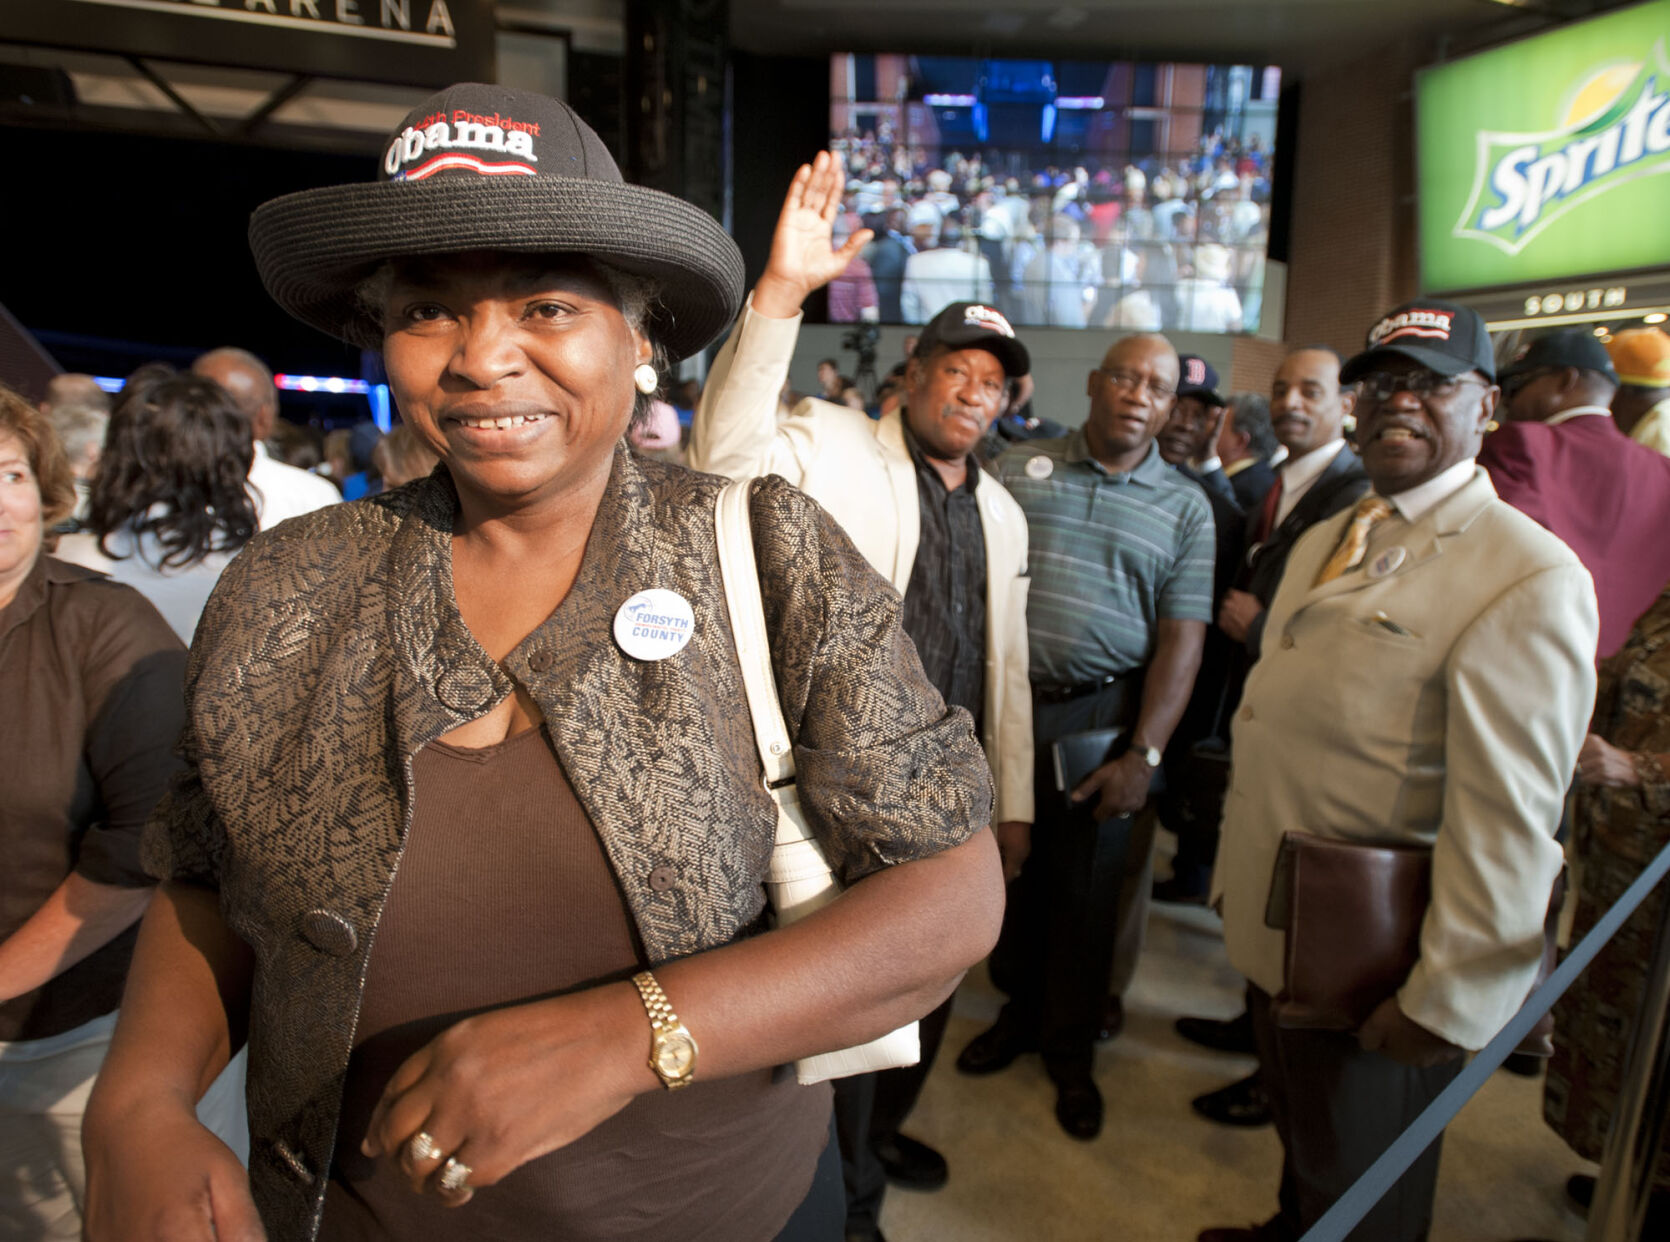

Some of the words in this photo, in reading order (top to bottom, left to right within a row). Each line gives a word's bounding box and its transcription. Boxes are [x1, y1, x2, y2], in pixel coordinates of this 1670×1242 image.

[385, 121, 538, 175] Obama
[1525, 288, 1626, 315] SOUTH
[1187, 357, 1205, 385] B
[636, 612, 689, 628] FORSYTH
[632, 626, 684, 642] COUNTY
